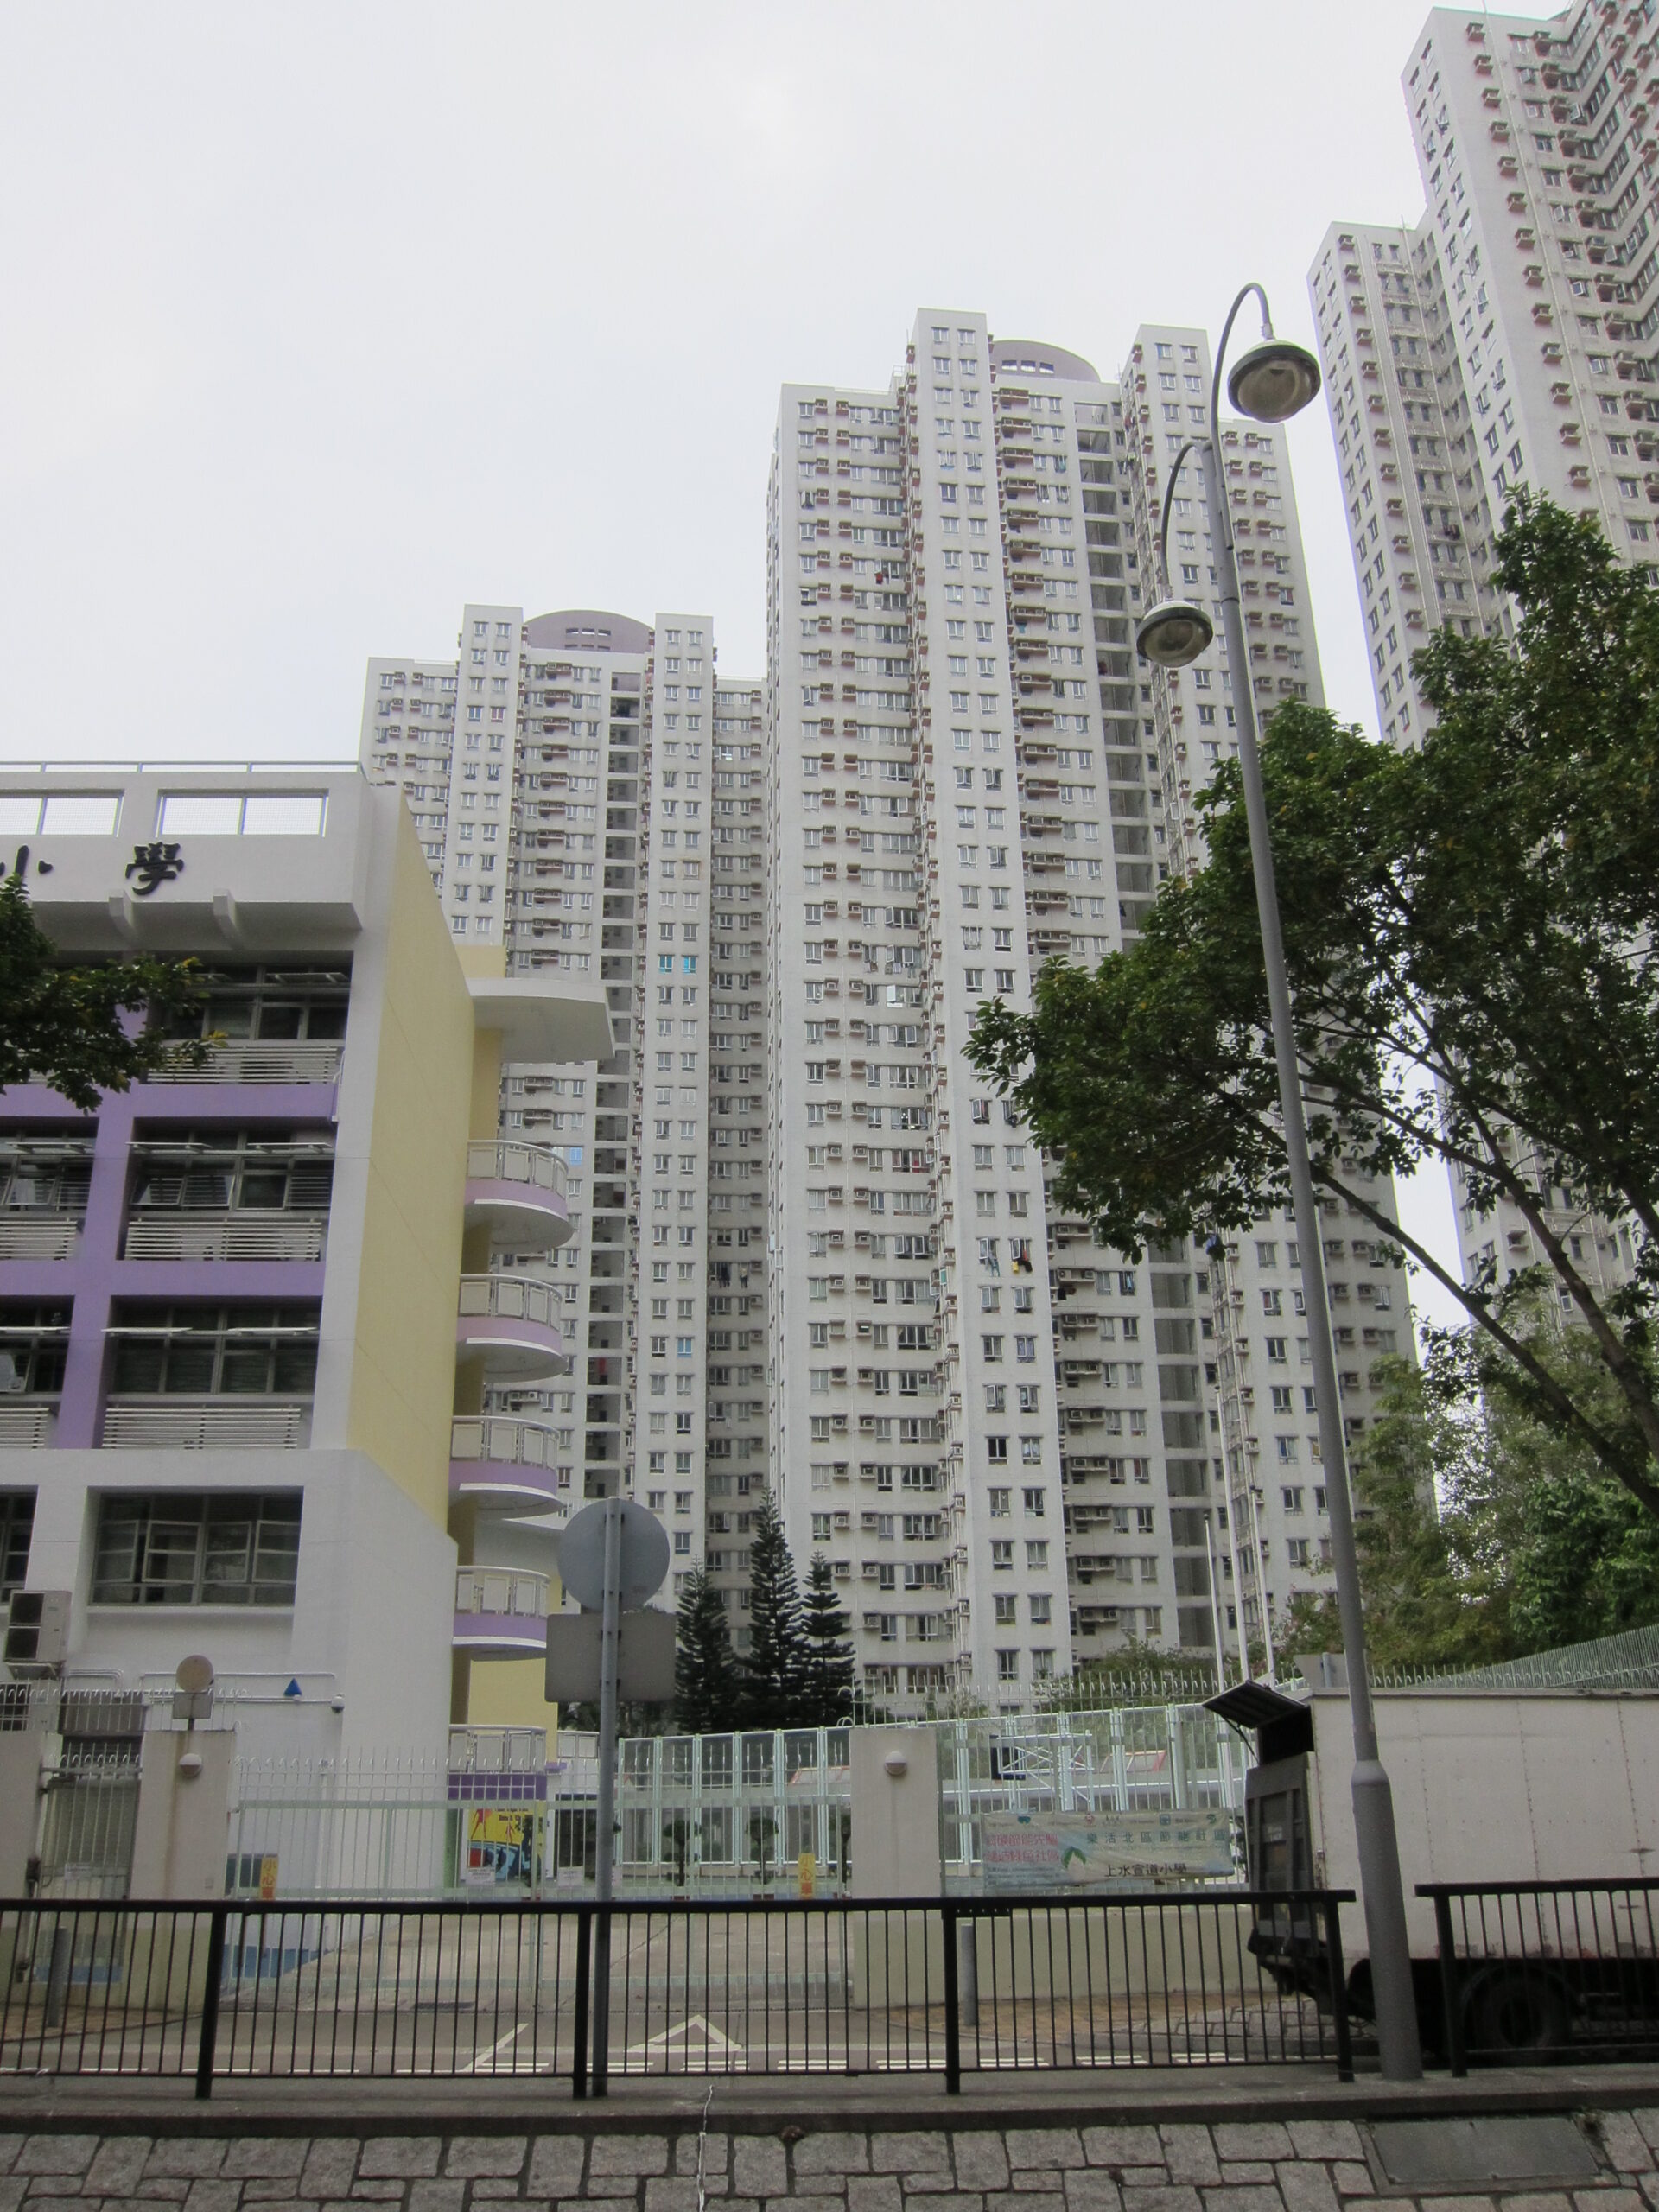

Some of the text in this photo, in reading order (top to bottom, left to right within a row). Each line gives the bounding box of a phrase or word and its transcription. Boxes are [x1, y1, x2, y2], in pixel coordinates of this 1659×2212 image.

[1104, 1862, 1187, 1878] 上水宣道小學
